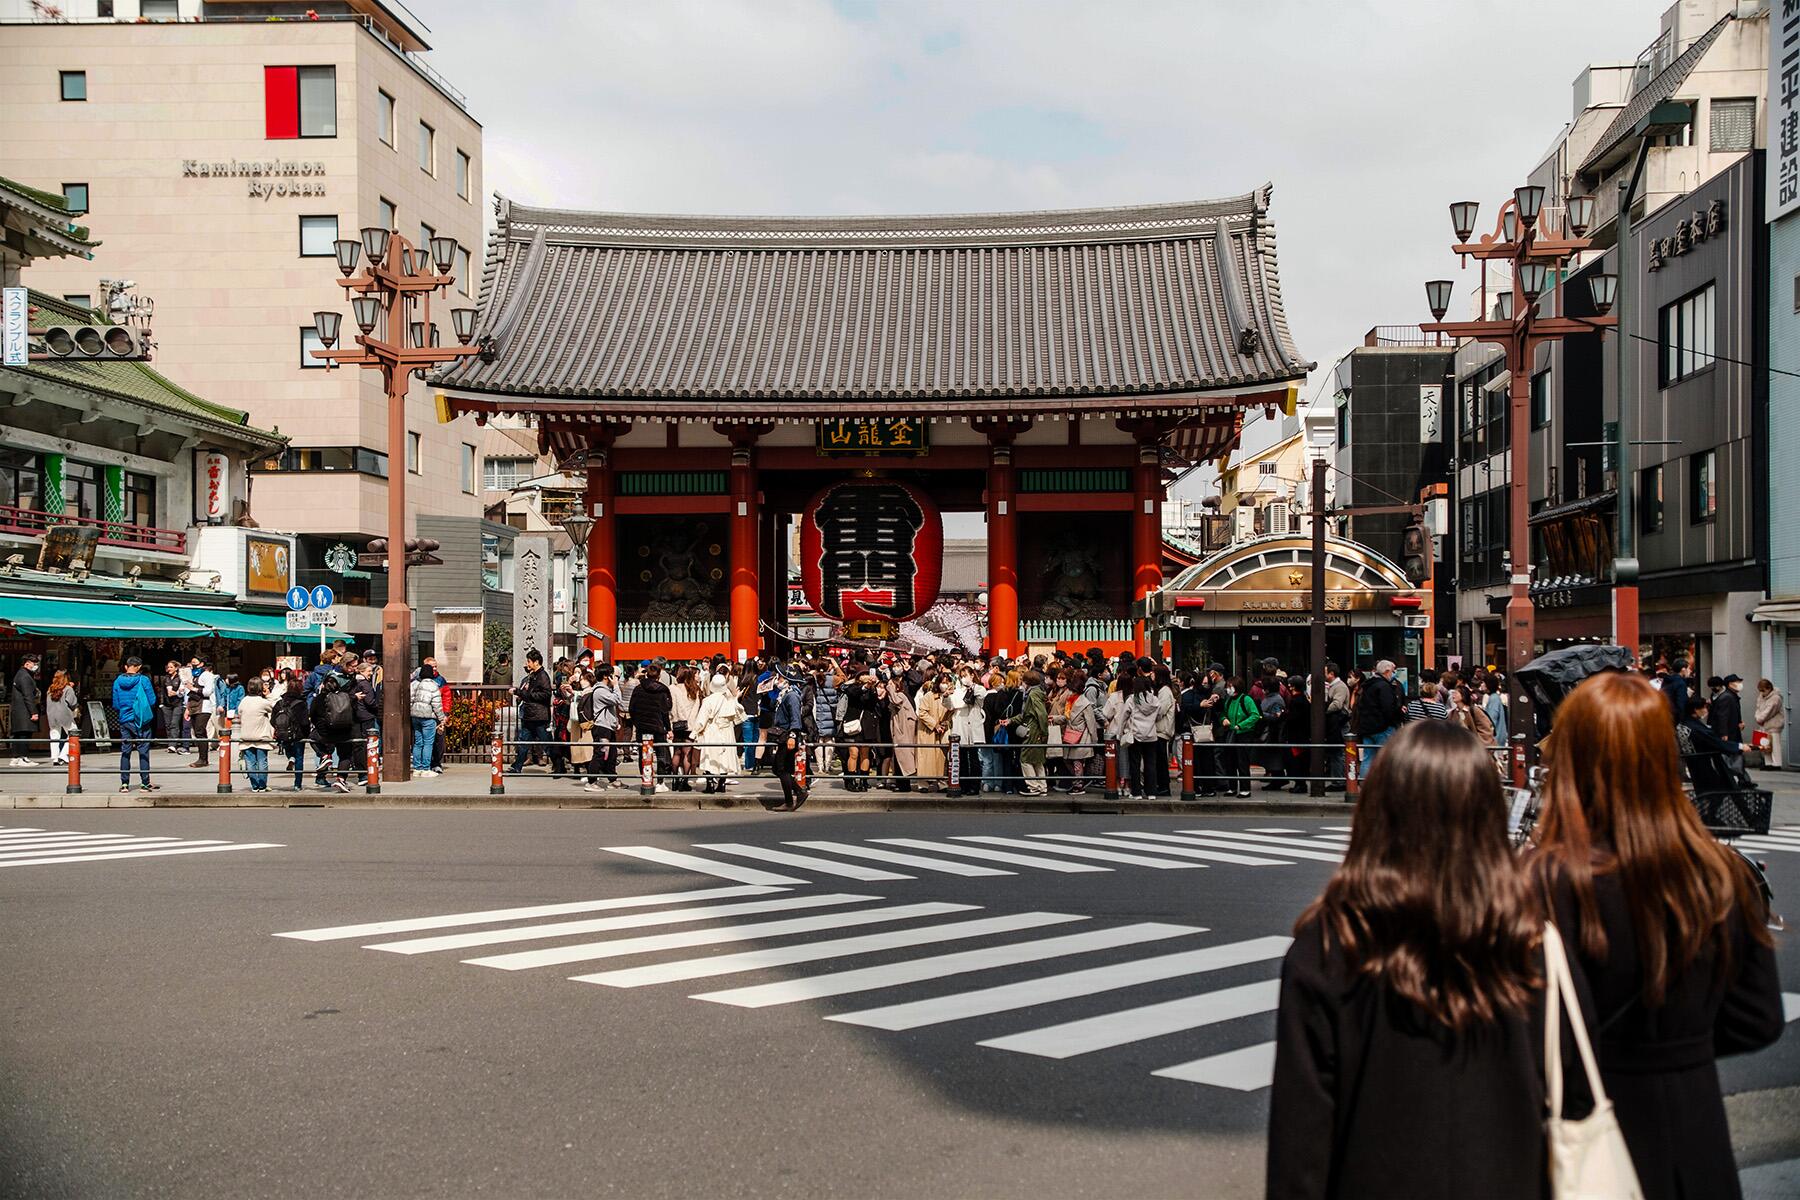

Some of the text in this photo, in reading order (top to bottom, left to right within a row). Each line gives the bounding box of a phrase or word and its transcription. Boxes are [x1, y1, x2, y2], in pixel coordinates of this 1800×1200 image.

[182, 158, 326, 178] Kaminarimon
[248, 178, 326, 202] Ryokan
[9, 291, 22, 362] スクランブル式
[813, 483, 925, 619] 雷門
[1247, 616, 1308, 624] KAMINARIMON
